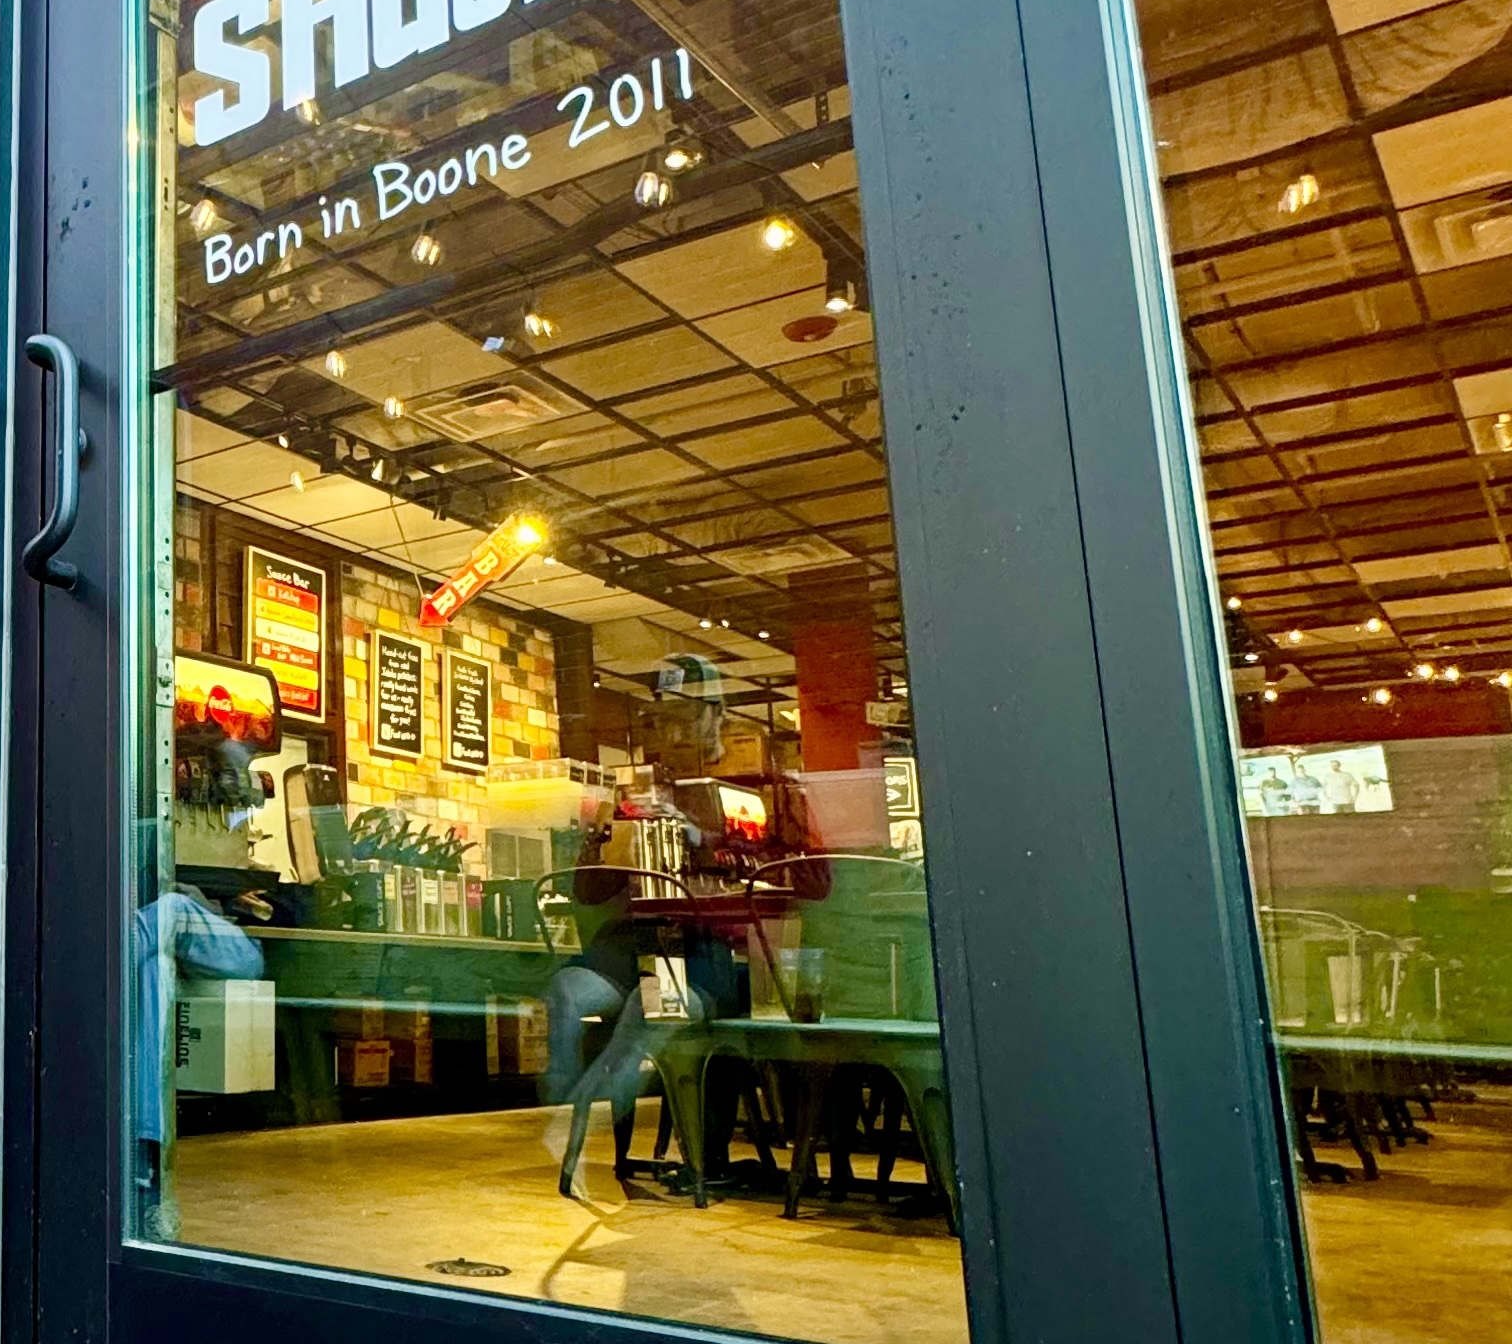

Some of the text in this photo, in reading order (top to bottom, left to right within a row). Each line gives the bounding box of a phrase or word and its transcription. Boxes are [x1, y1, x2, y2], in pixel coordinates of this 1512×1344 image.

[204, 48, 693, 285] Born in Boone 2011
[293, 572, 310, 590] Bar
[432, 550, 499, 616] BAR
